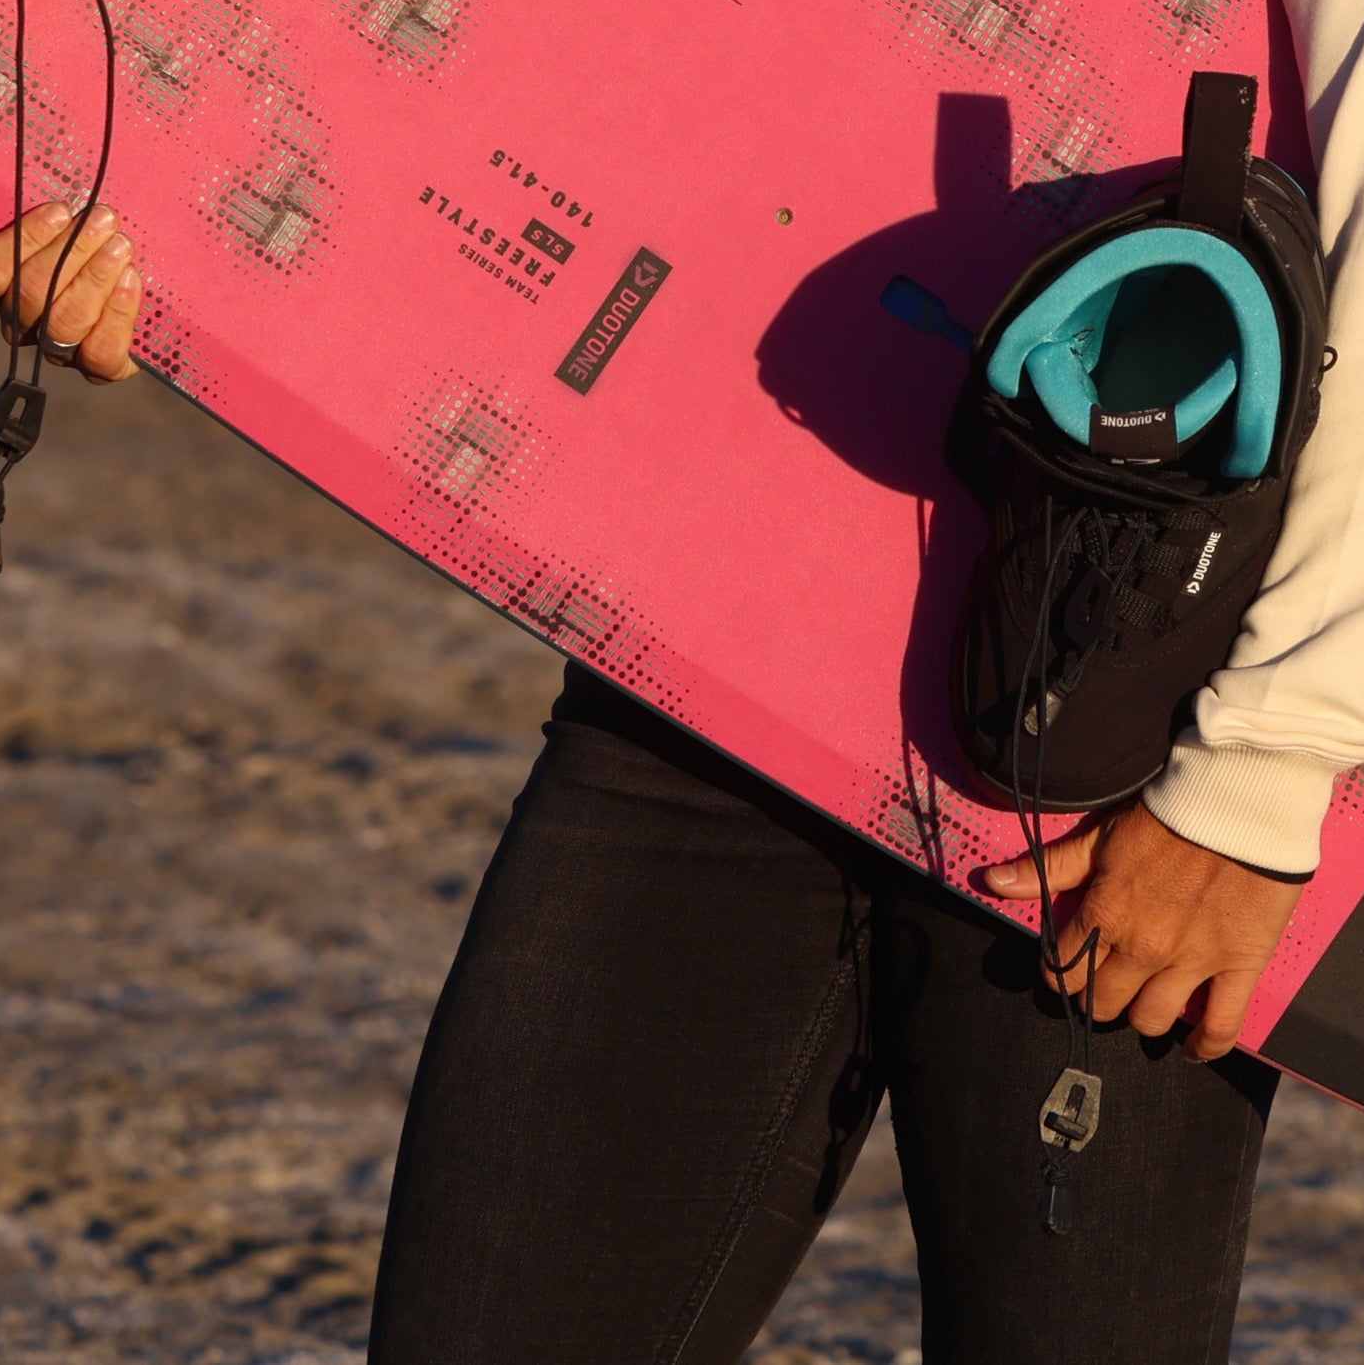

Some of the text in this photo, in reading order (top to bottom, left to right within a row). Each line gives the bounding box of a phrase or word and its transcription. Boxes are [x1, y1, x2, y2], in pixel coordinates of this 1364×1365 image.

[489, 149, 594, 228] 140-41.5
[419, 186, 556, 287] FREESTYLE
[530, 229, 565, 256] SLS
[457, 243, 540, 305] TEAM SERIES
[567, 287, 641, 381] DUOTONE
[1100, 414, 1152, 428] DUOTONE
[1192, 531, 1222, 581] DUOTONE
